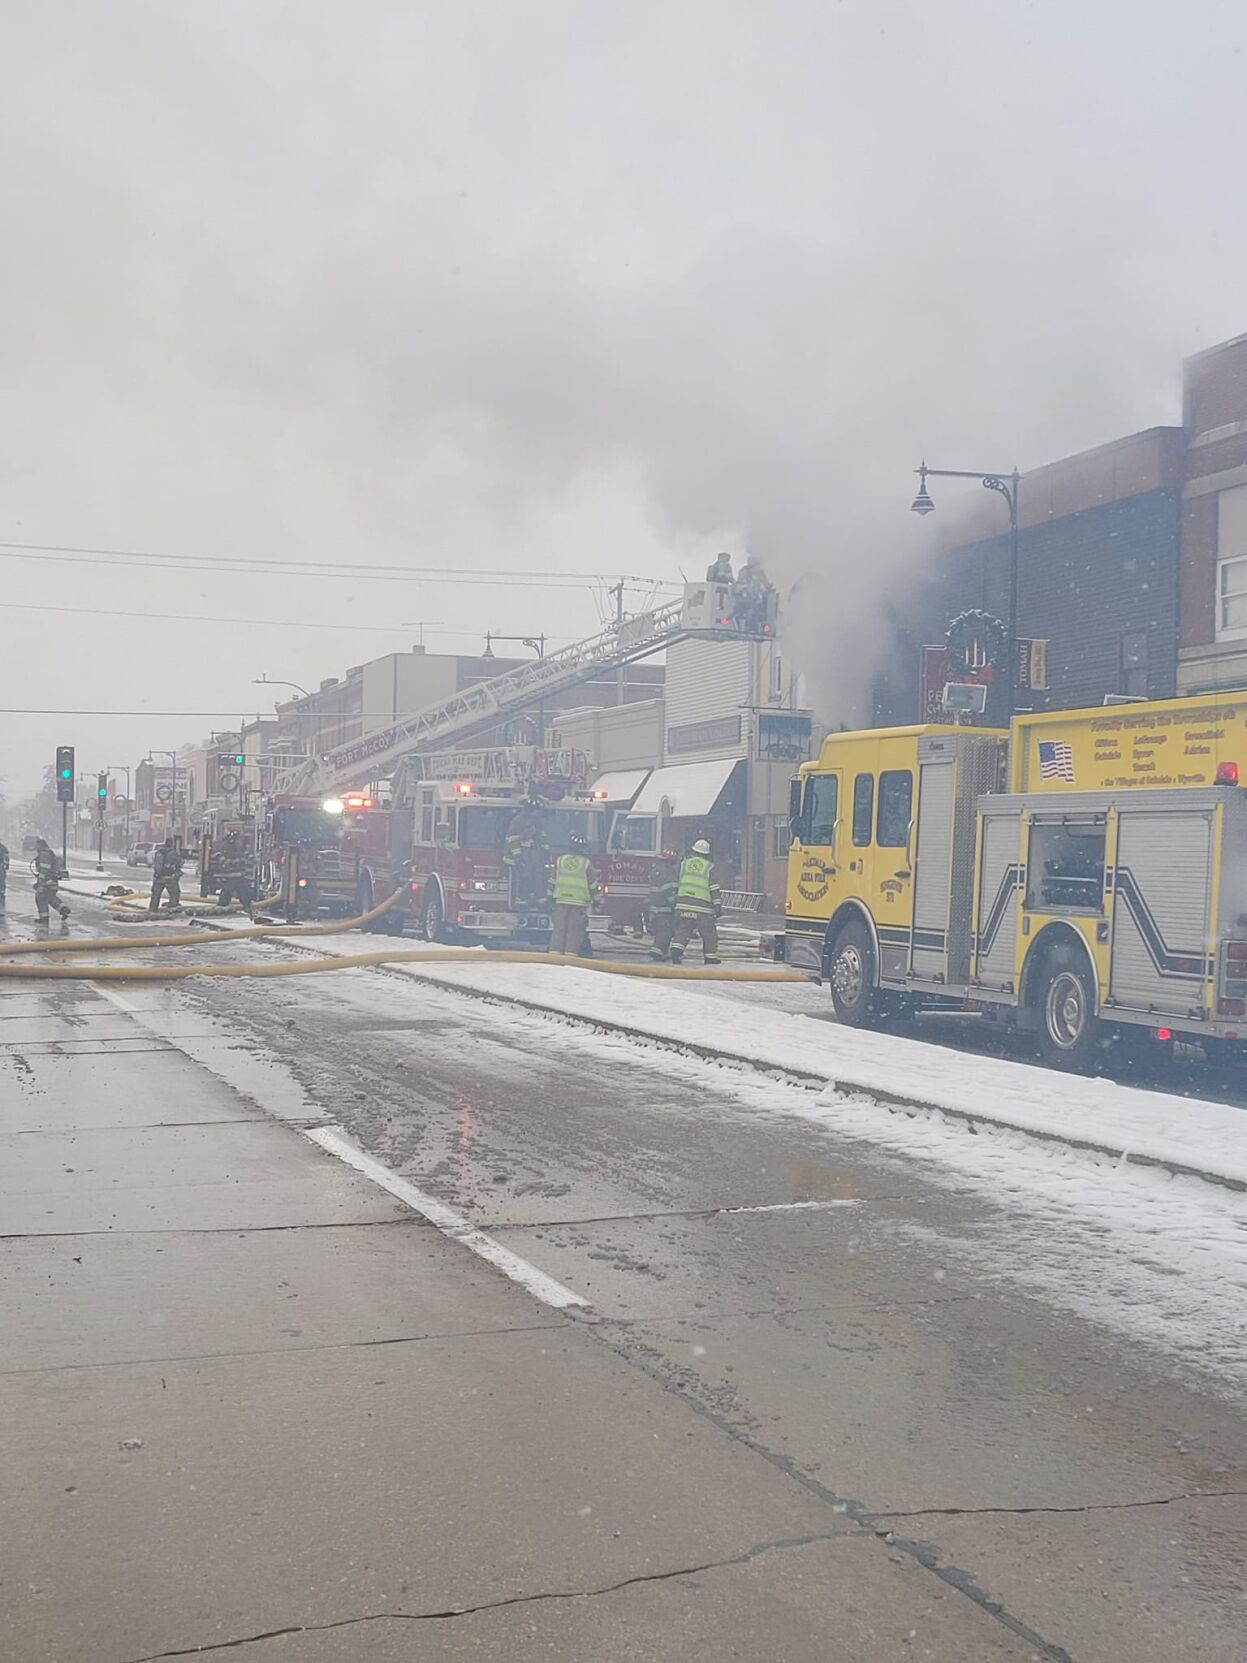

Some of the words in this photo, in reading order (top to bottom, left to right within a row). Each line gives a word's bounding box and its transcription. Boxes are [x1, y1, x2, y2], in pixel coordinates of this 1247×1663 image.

[1019, 645, 1029, 683] TOMAH
[336, 749, 360, 768] FORT
[361, 729, 394, 757] McCOY
[609, 861, 645, 873] TOMAH
